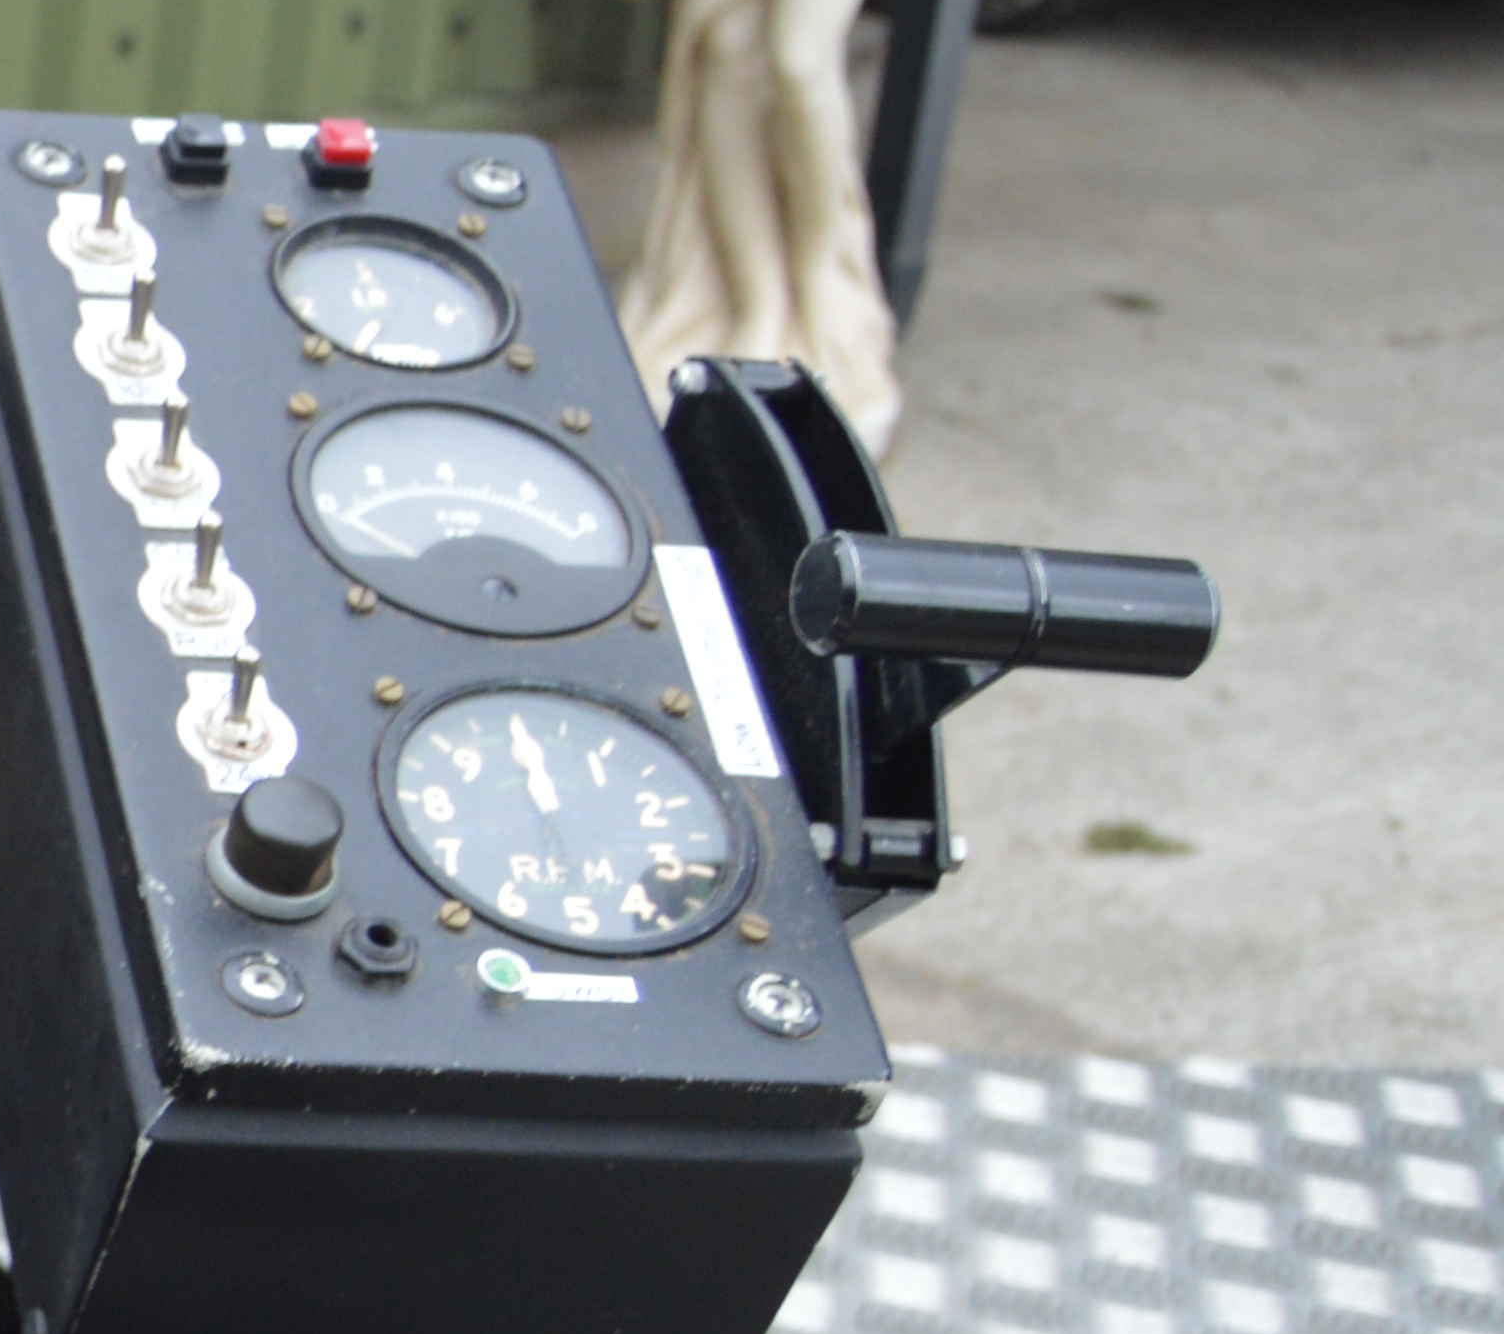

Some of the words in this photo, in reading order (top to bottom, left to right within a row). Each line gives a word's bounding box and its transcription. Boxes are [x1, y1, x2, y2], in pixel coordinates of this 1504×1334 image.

[451, 745, 483, 784] 9
[586, 749, 608, 788] 1
[421, 785, 456, 823] 8
[635, 790, 670, 828] 2
[434, 837, 463, 878] 7
[647, 842, 685, 881] 3
[497, 880, 529, 918] 6
[561, 895, 600, 936] 5
[619, 882, 657, 922] 4
